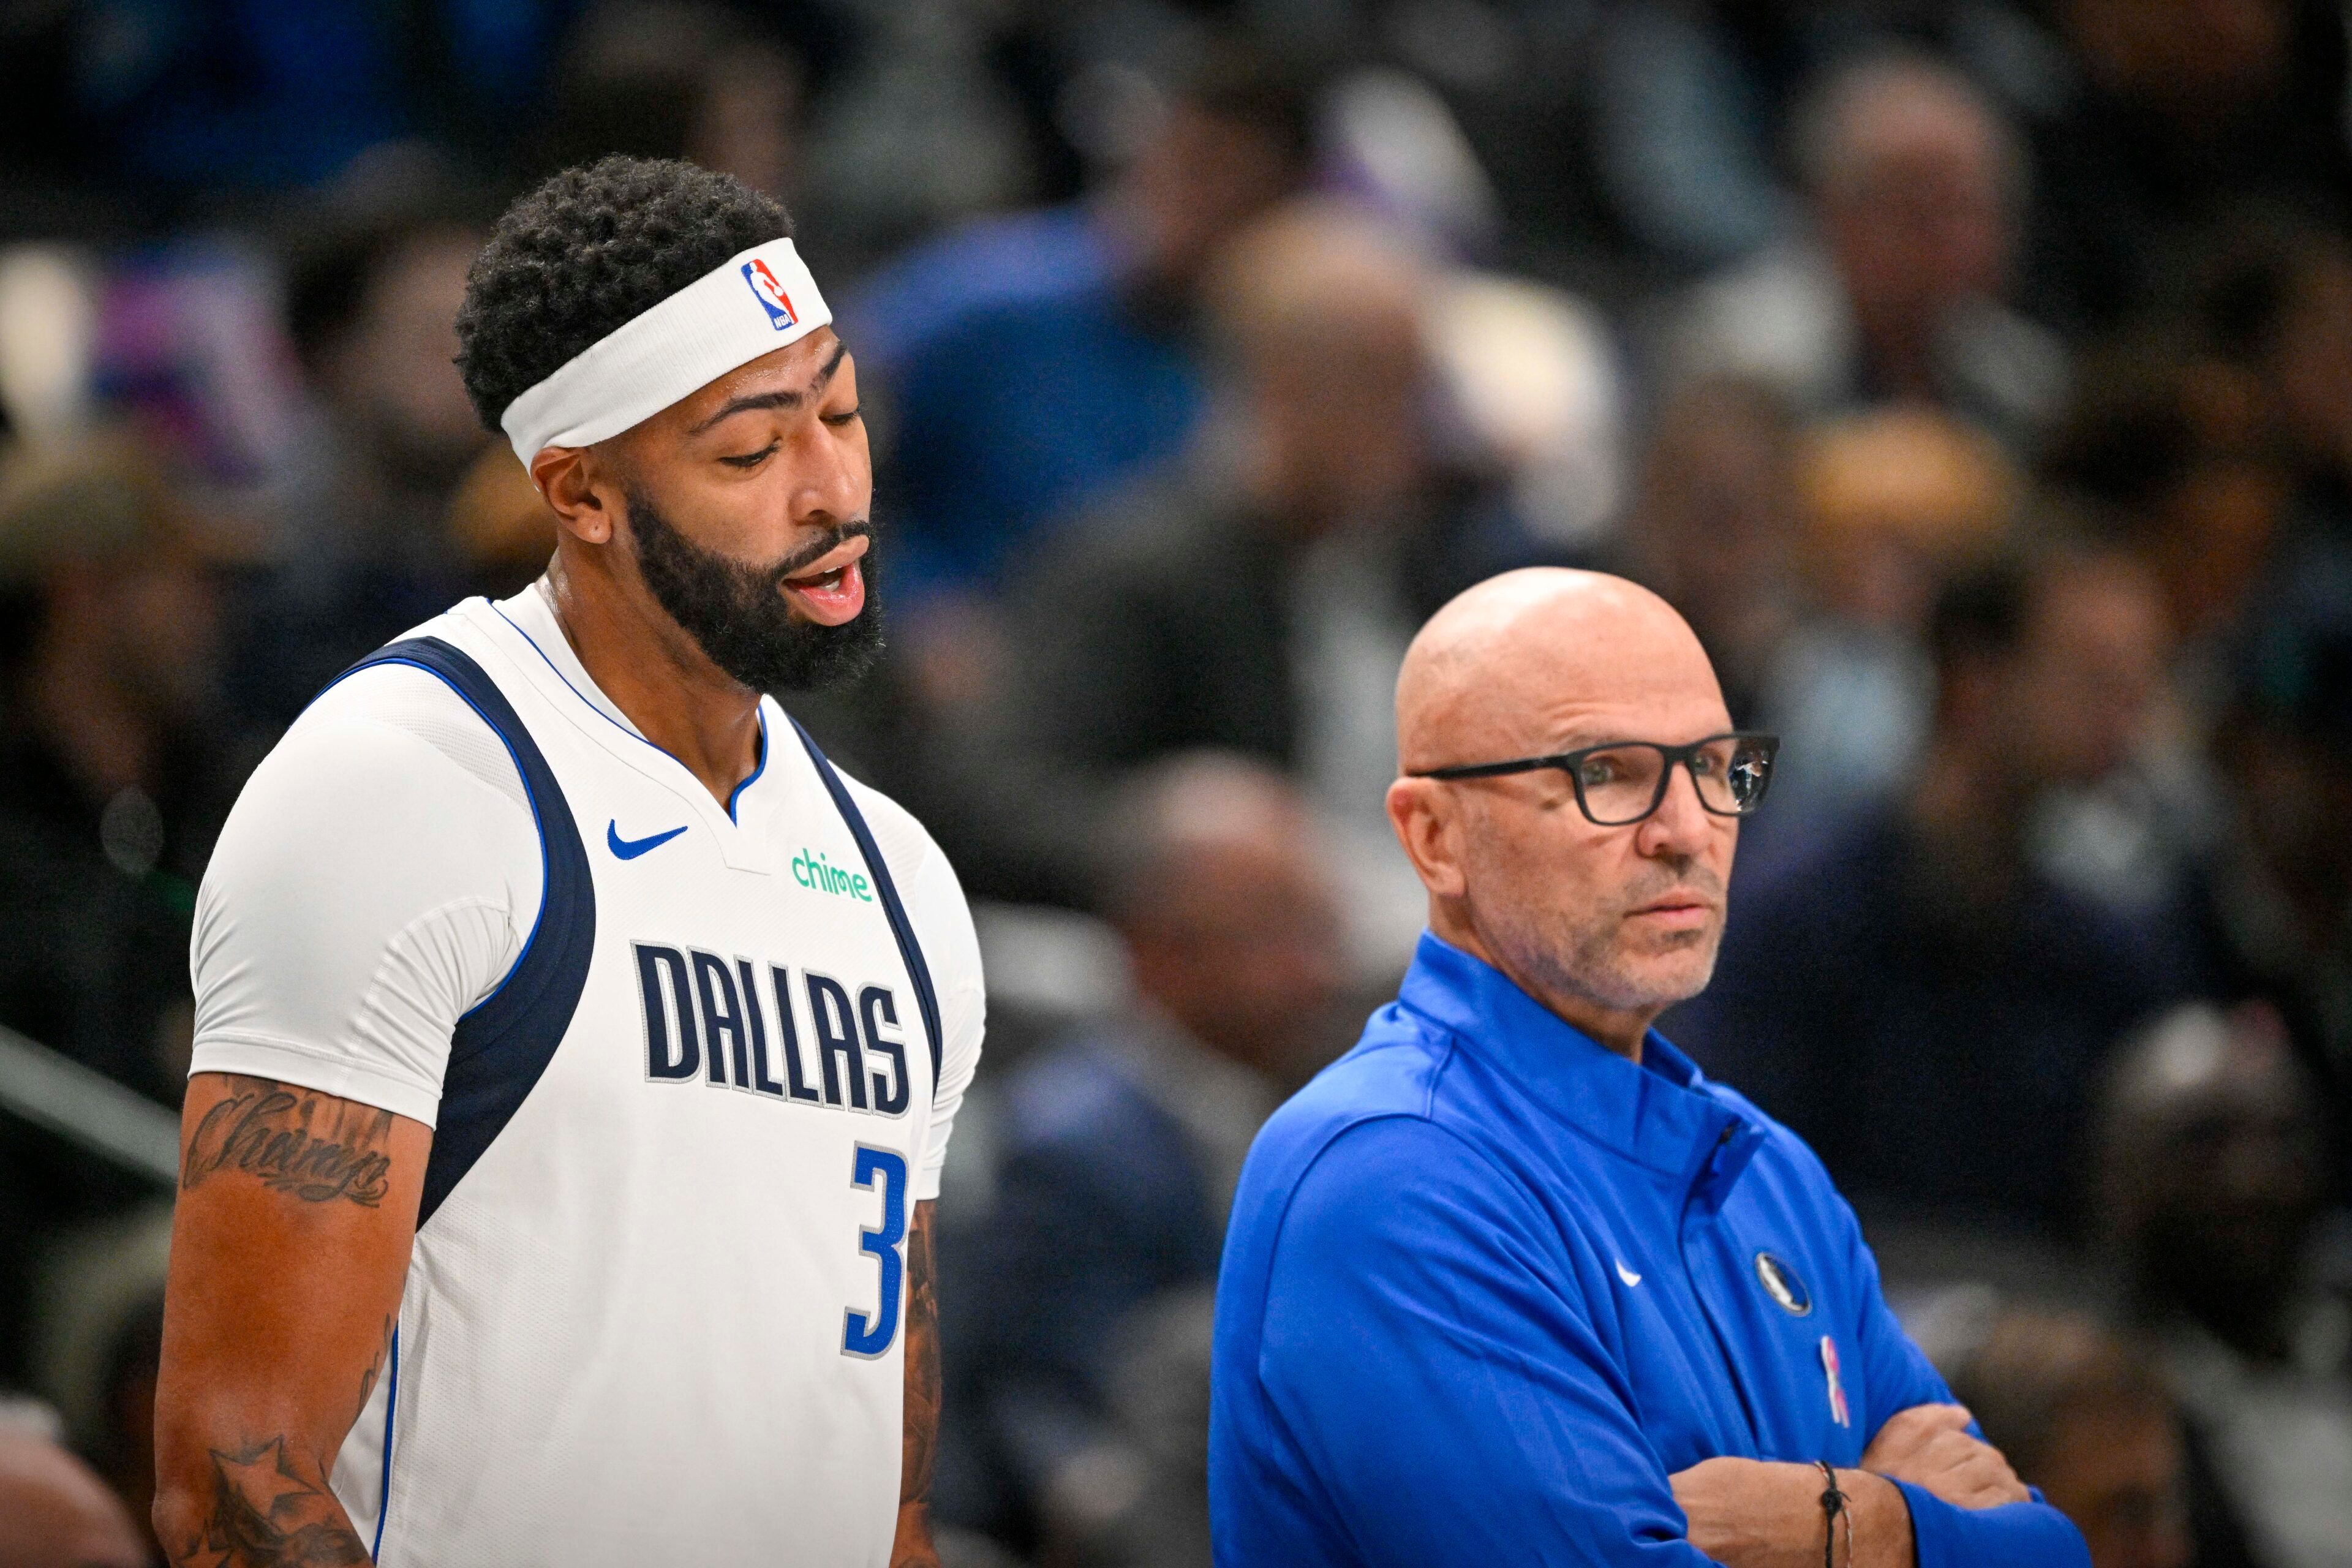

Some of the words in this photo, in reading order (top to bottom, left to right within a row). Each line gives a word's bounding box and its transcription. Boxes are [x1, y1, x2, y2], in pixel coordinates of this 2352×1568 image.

[773, 314, 791, 328] NBA
[791, 848, 873, 902] chime
[629, 939, 913, 1120] DALLAS
[840, 1140, 910, 1361] 3
